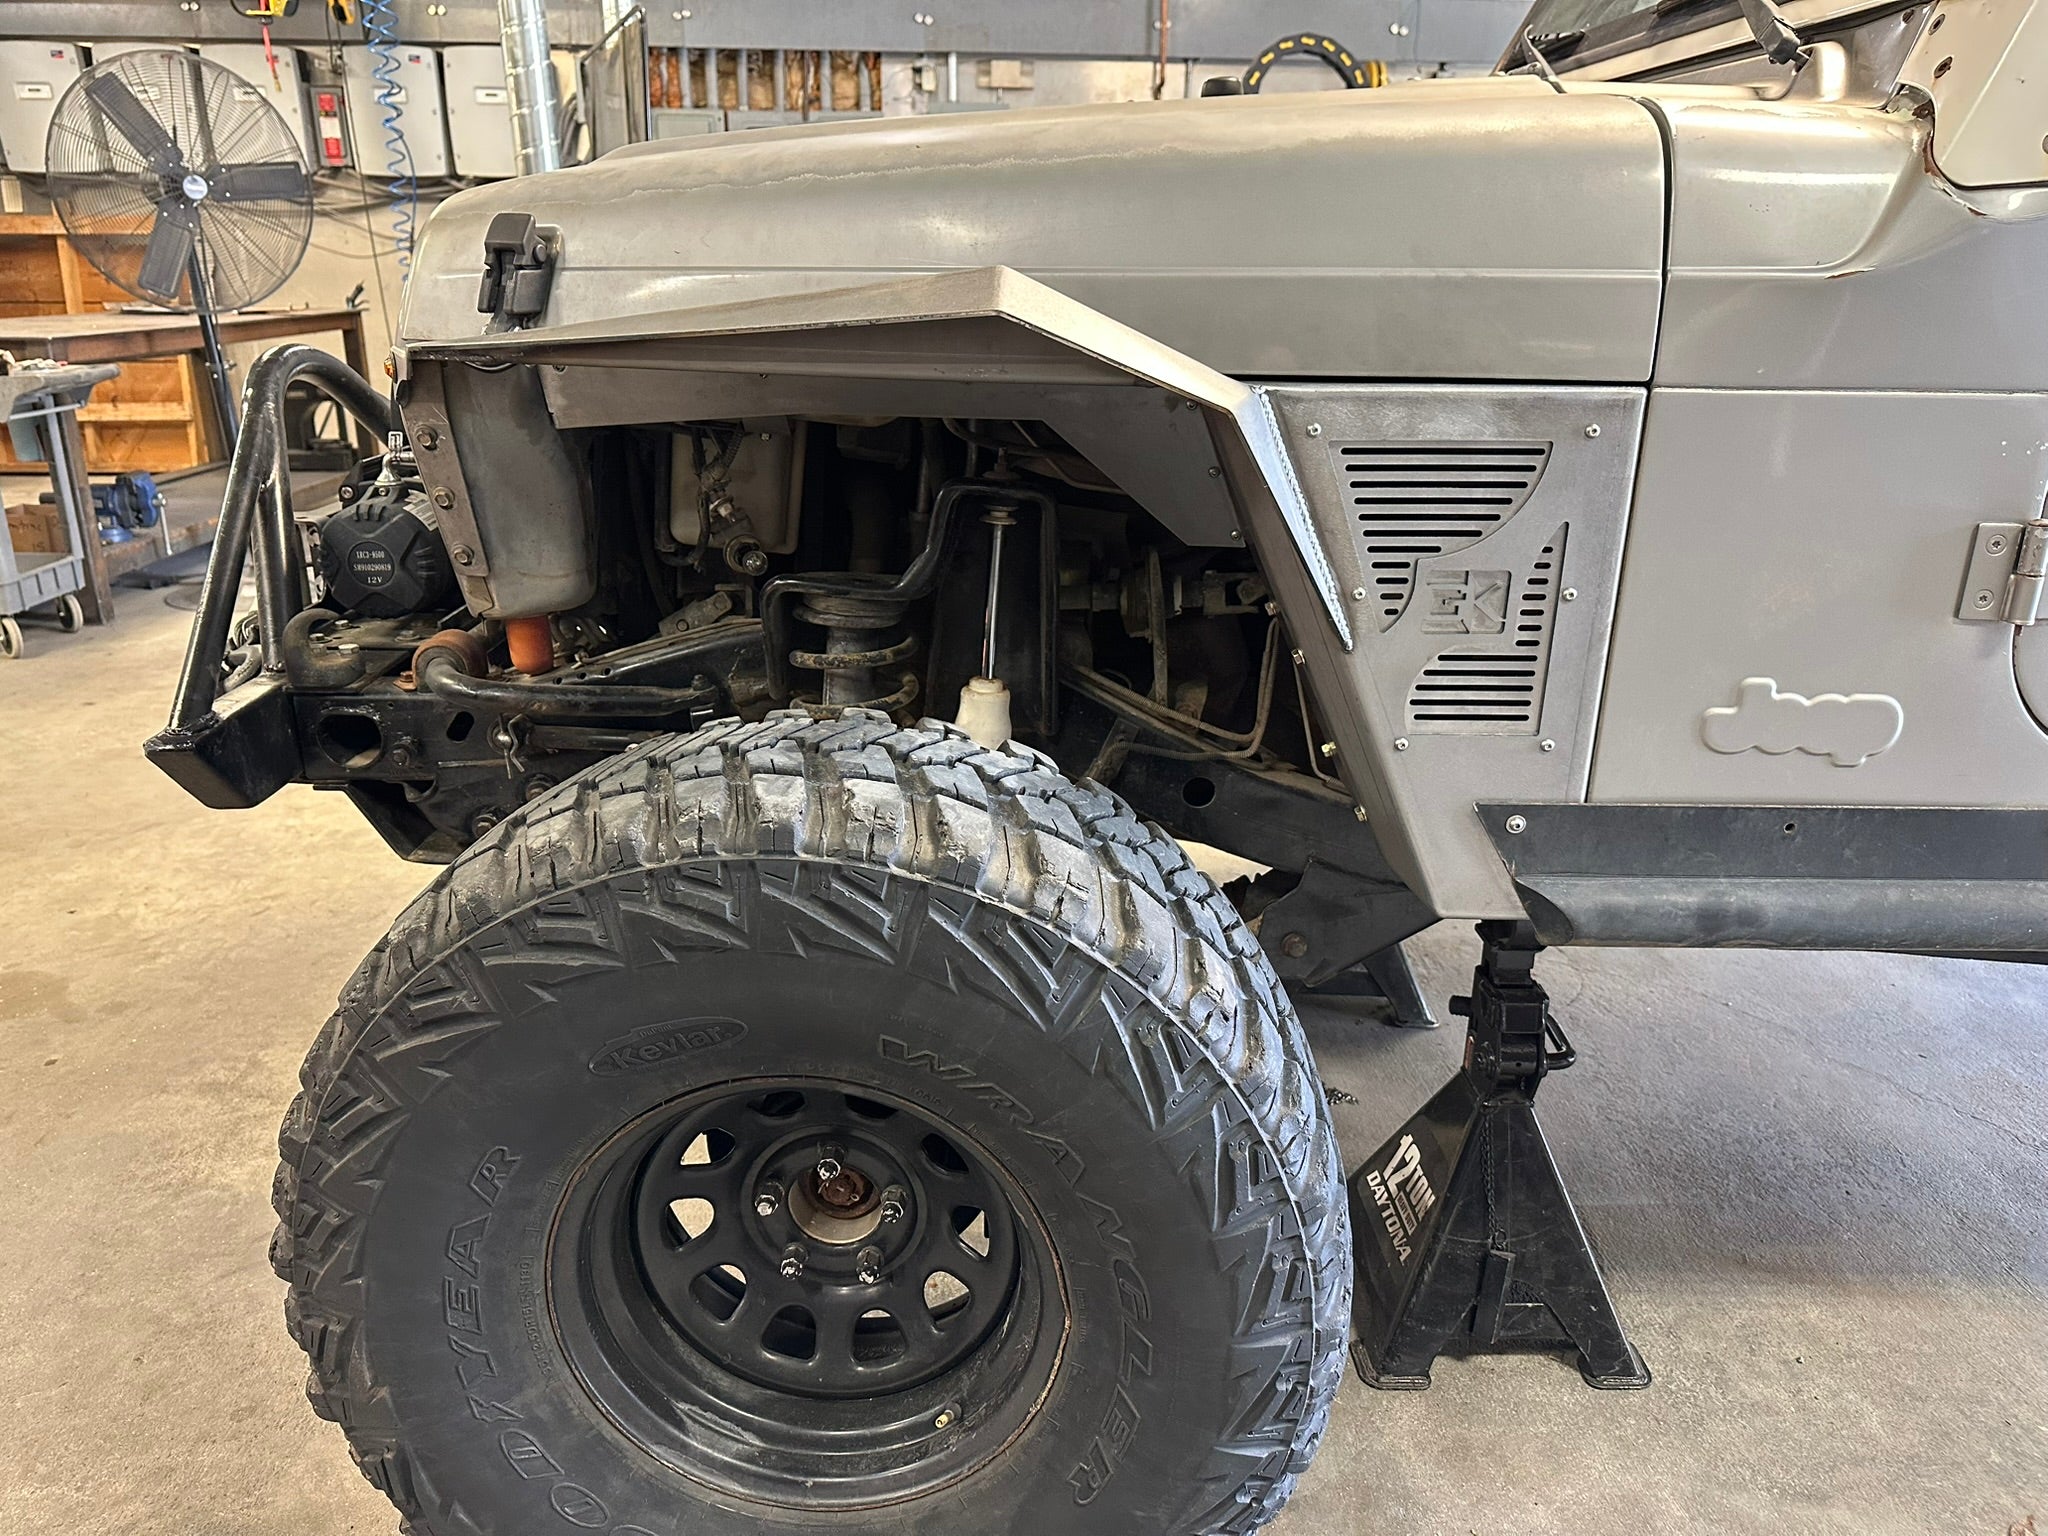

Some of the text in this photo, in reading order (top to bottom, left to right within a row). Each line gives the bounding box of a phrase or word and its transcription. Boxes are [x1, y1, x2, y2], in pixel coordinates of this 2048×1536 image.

[367, 576, 383, 584] 12V
[609, 1026, 721, 1069] Kevlar
[1366, 1169, 1413, 1263] DAYTONA
[1382, 1133, 1436, 1222] 12 TON
[878, 1034, 1154, 1507] WRANGLER
